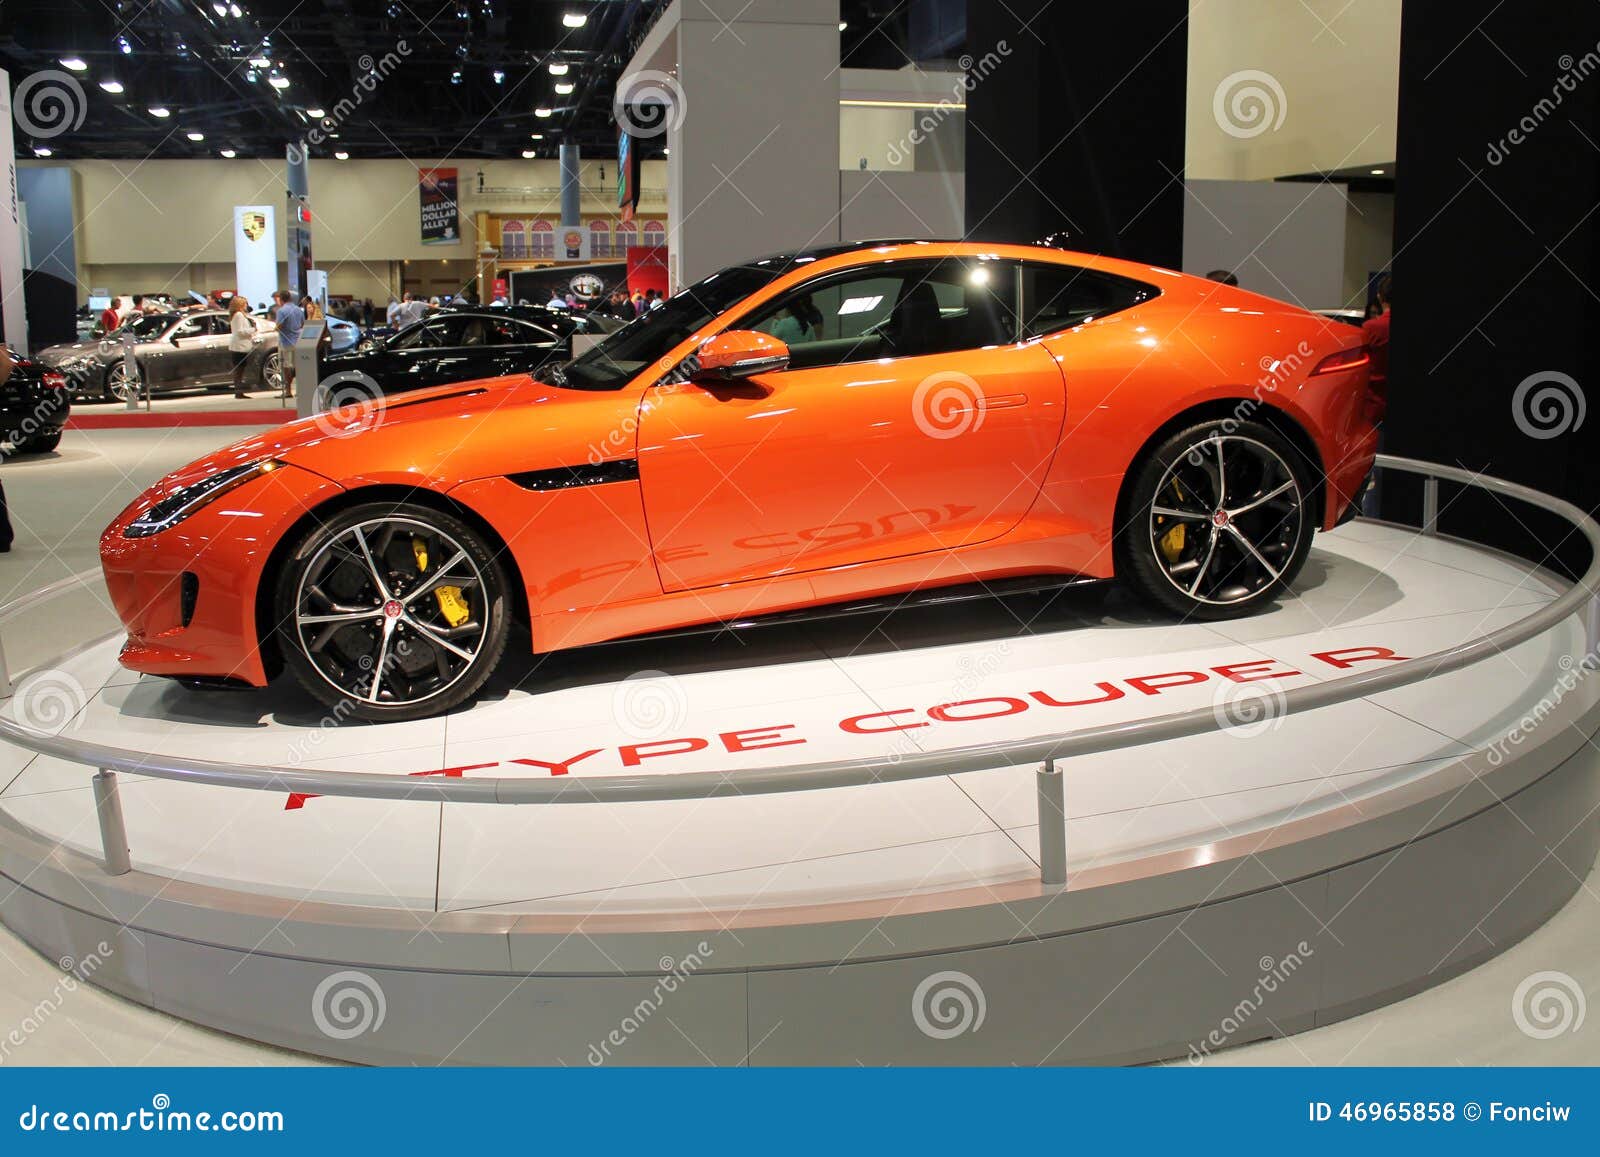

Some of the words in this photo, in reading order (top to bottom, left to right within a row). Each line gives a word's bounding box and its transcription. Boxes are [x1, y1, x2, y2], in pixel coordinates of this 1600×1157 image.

[422, 200, 457, 213] MILLION
[422, 209, 457, 222] DOLLAR
[422, 219, 449, 230] ALLEY
[838, 659, 1301, 735] COUPE
[1312, 646, 1412, 668] R
